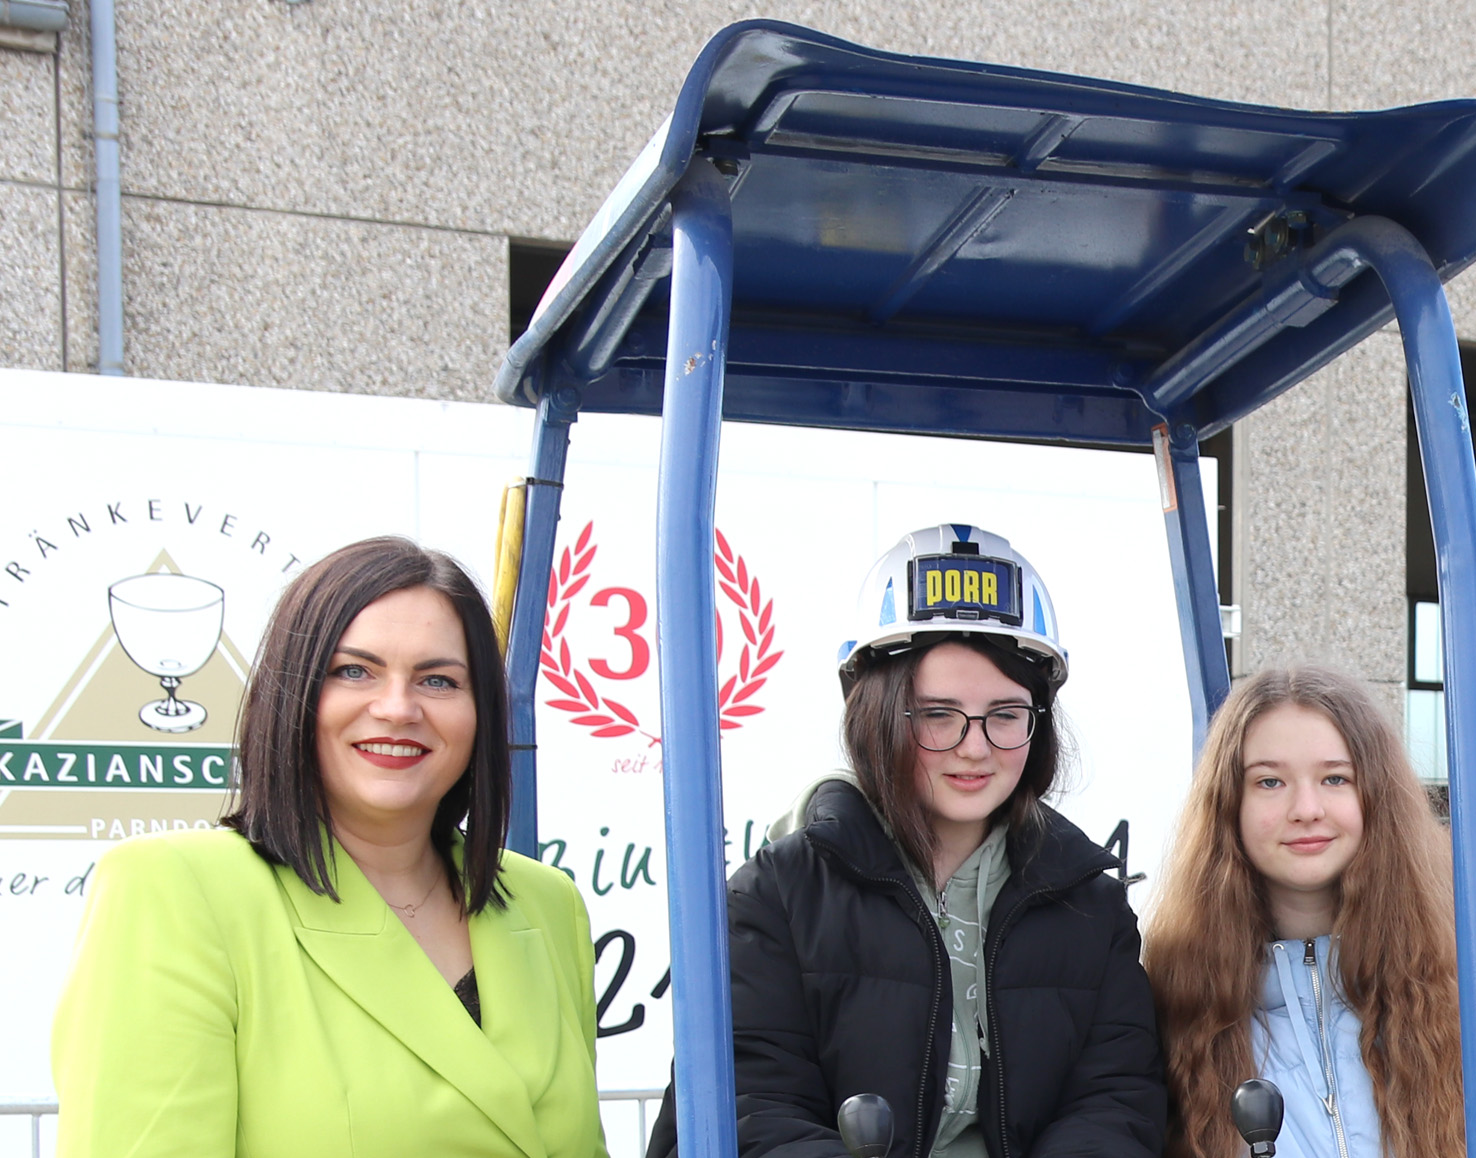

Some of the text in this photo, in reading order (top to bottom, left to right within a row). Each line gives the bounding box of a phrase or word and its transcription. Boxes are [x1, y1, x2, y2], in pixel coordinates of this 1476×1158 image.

[0, 499, 300, 606] RÄNKEVERT
[926, 569, 998, 606] PORR
[0, 752, 240, 784] KAZIANSC
